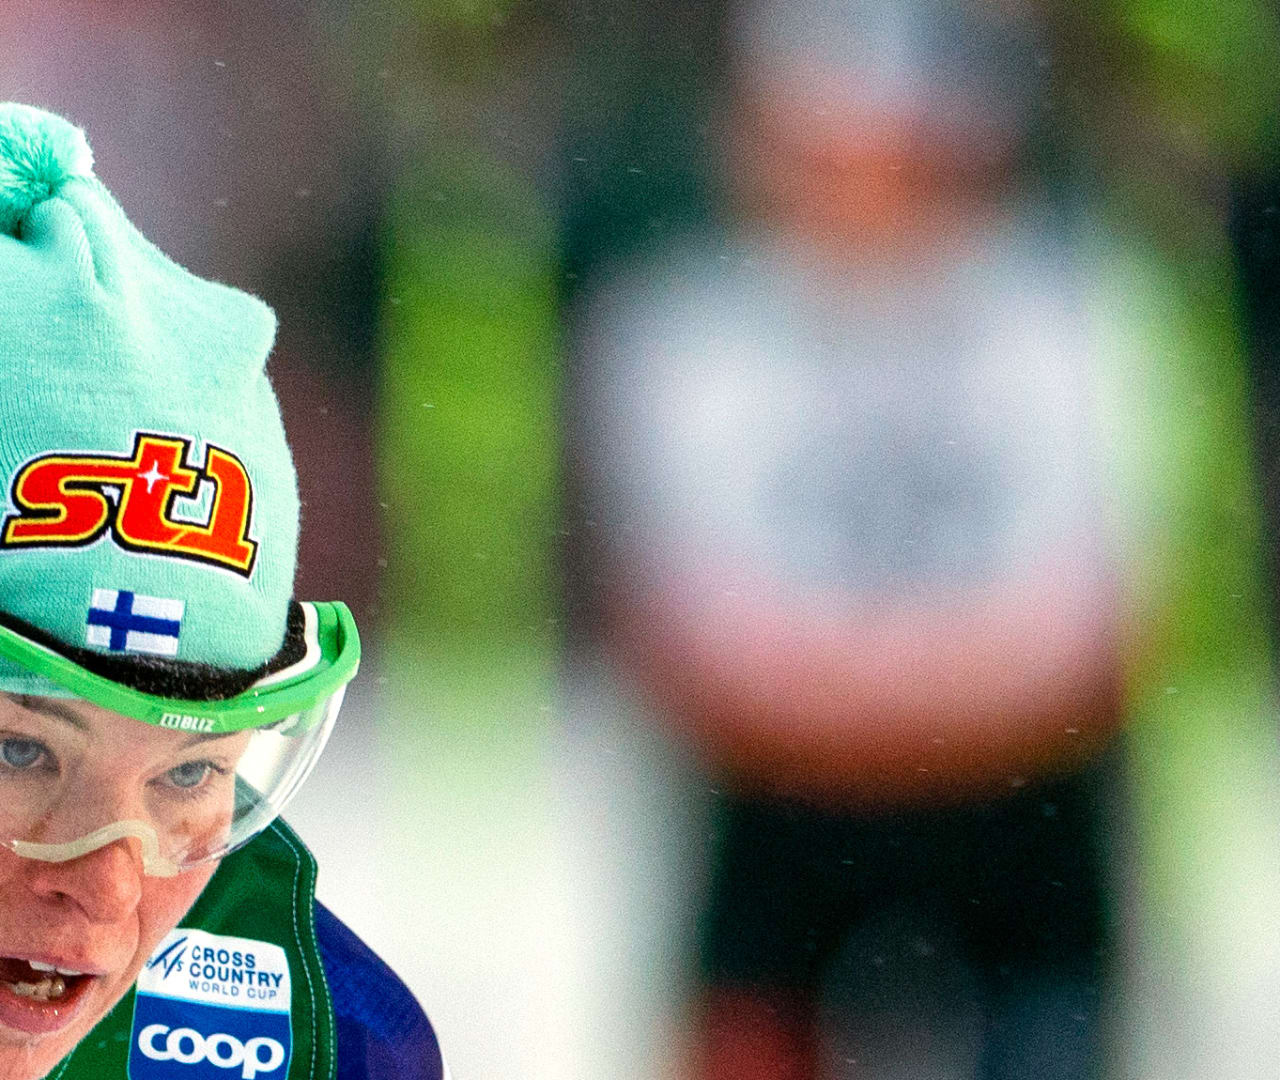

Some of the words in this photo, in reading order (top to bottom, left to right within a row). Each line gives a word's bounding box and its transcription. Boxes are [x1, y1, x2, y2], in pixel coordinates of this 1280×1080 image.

[191, 945, 256, 969] CROSS
[189, 962, 283, 988] COUNTRY
[189, 979, 240, 996] WORLD
[246, 986, 278, 1000] CUP
[137, 1023, 285, 1080] coop
